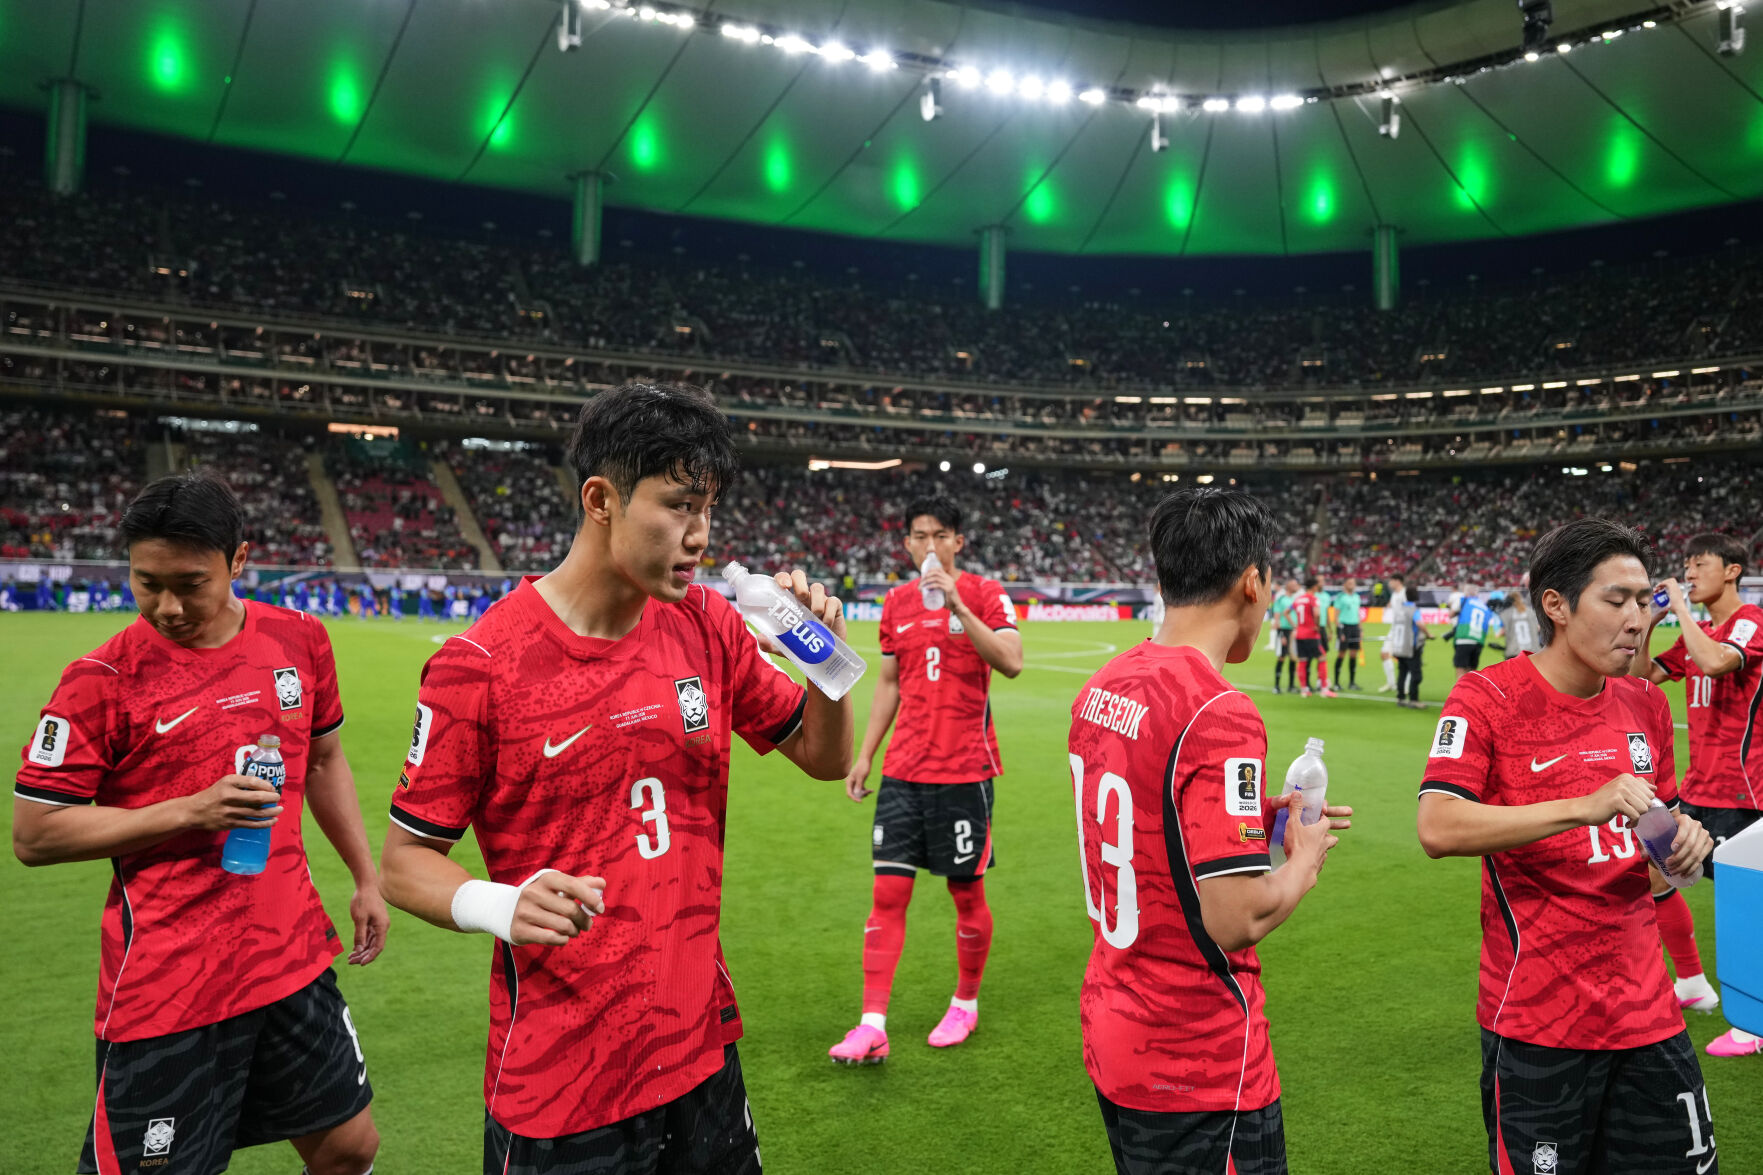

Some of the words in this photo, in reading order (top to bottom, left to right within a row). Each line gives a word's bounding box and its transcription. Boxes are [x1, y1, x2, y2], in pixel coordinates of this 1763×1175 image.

[768, 599, 824, 653] smart
[1027, 603, 1120, 621] McDonald's
[925, 646, 940, 681] 2
[1690, 675, 1712, 708] 10
[685, 734, 712, 748] KOREA
[630, 777, 671, 860] 3
[954, 820, 974, 854] 2
[1069, 752, 1140, 949] 13
[1588, 815, 1636, 866] 19
[1677, 1084, 1717, 1158] 1
[140, 1157, 169, 1168] KOREA
